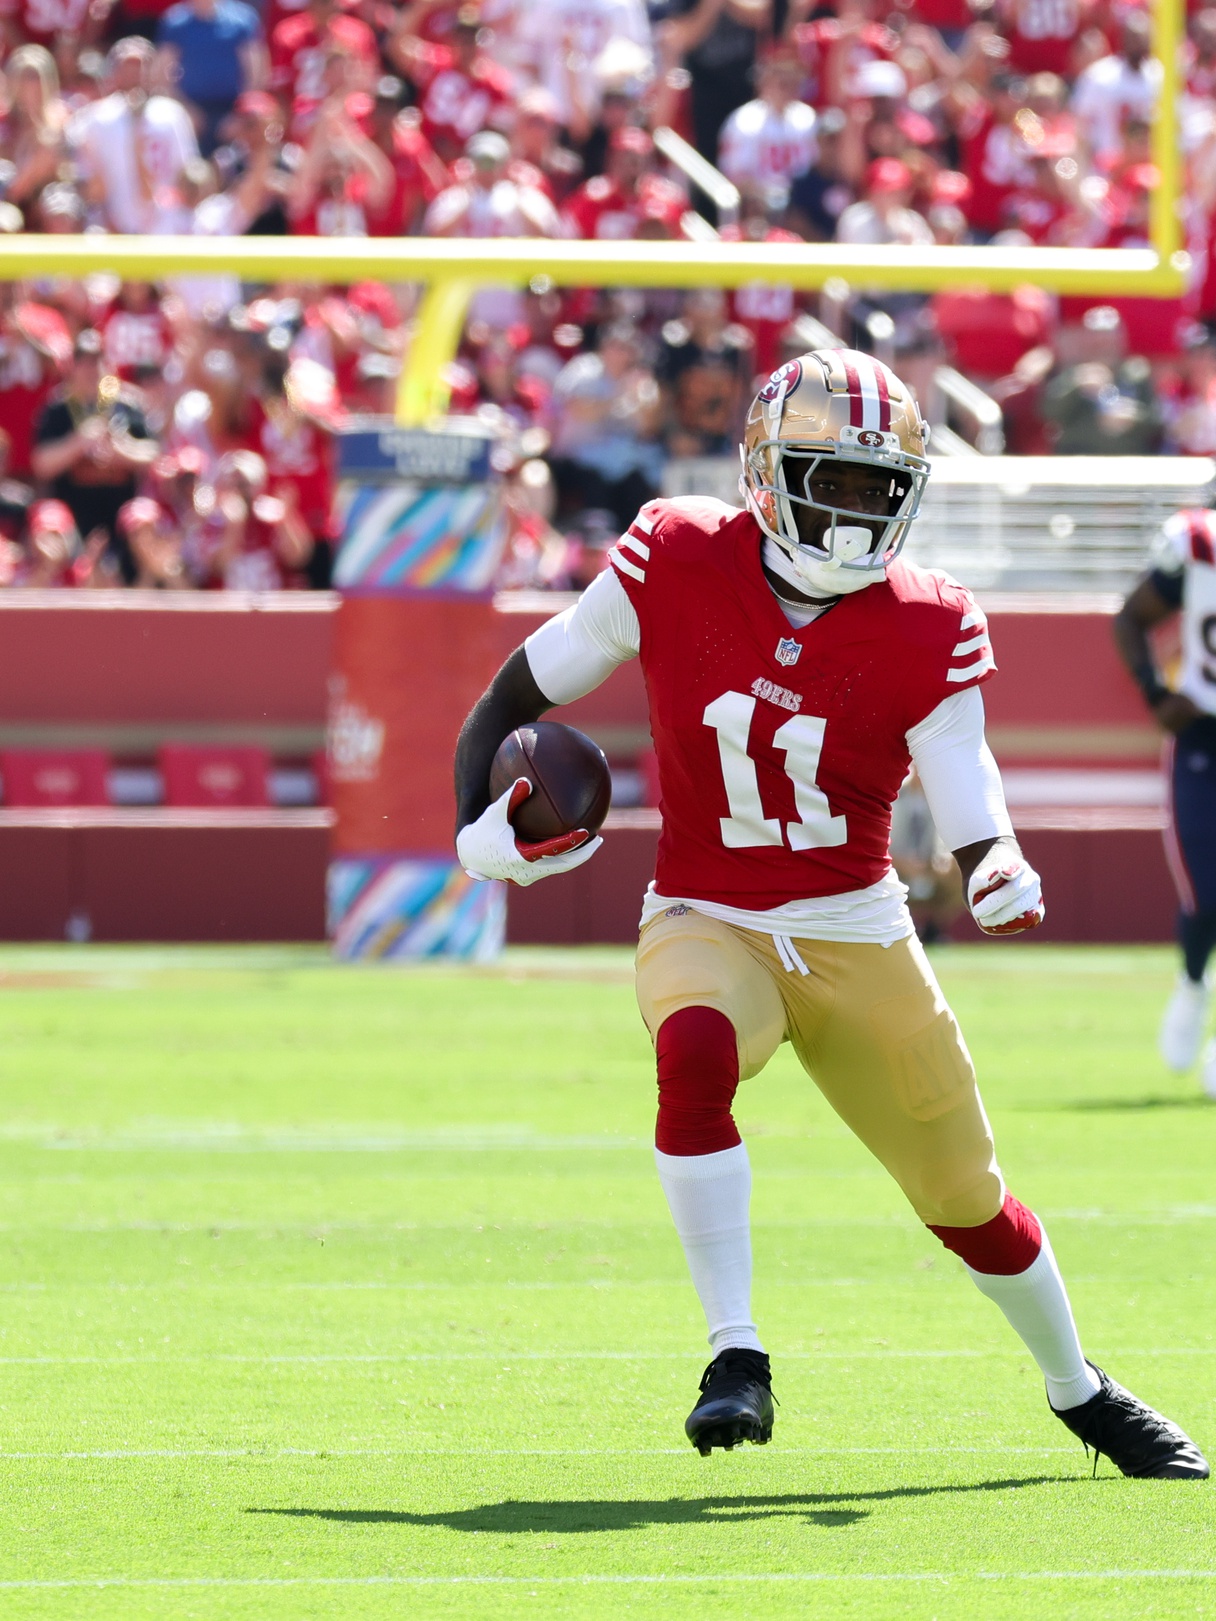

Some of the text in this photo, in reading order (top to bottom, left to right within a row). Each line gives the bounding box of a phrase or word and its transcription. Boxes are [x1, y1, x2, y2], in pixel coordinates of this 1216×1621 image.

[779, 648, 796, 662] NFL
[751, 676, 803, 712] 49ERS
[702, 690, 848, 851] 11
